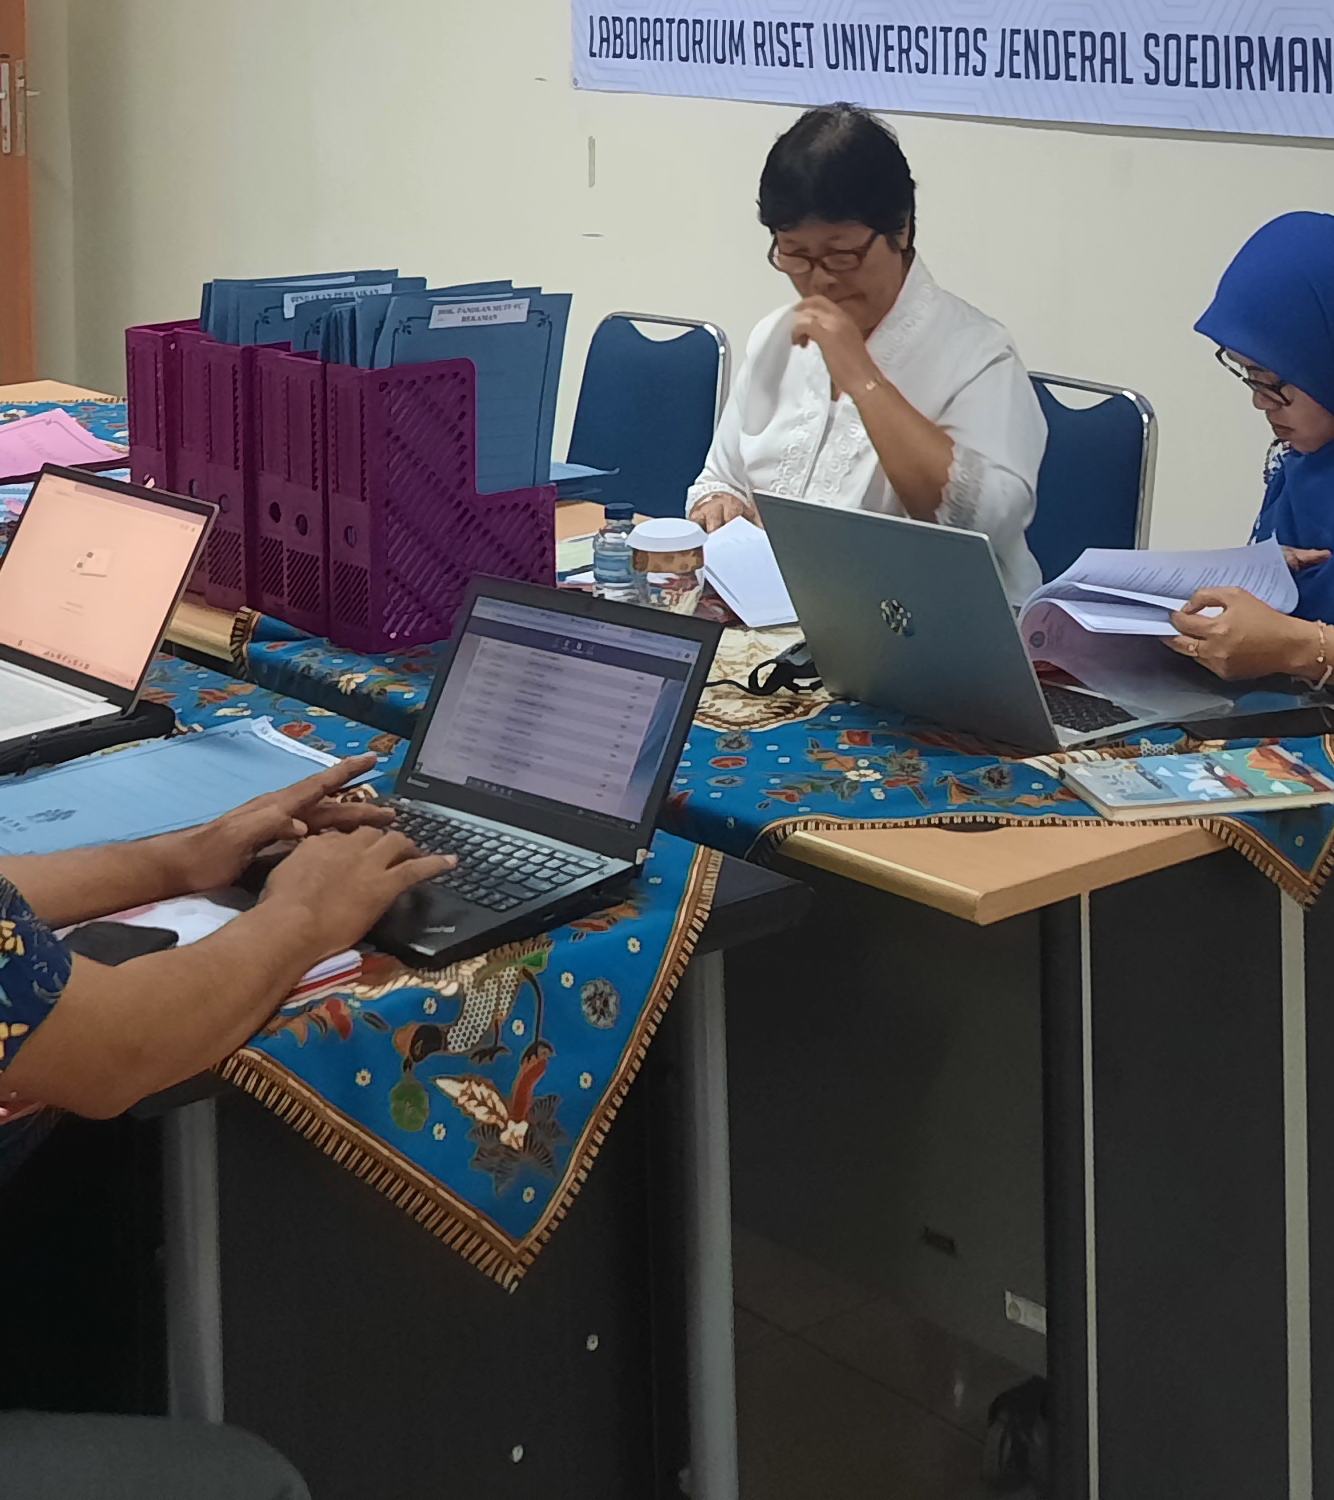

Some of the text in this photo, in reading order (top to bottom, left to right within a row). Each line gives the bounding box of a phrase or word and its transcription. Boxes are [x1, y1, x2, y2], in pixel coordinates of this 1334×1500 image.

[588, 14, 1333, 94] LABORATORIUM RISET UNIVERSITAS JENDERAL SOEDIRMAN
